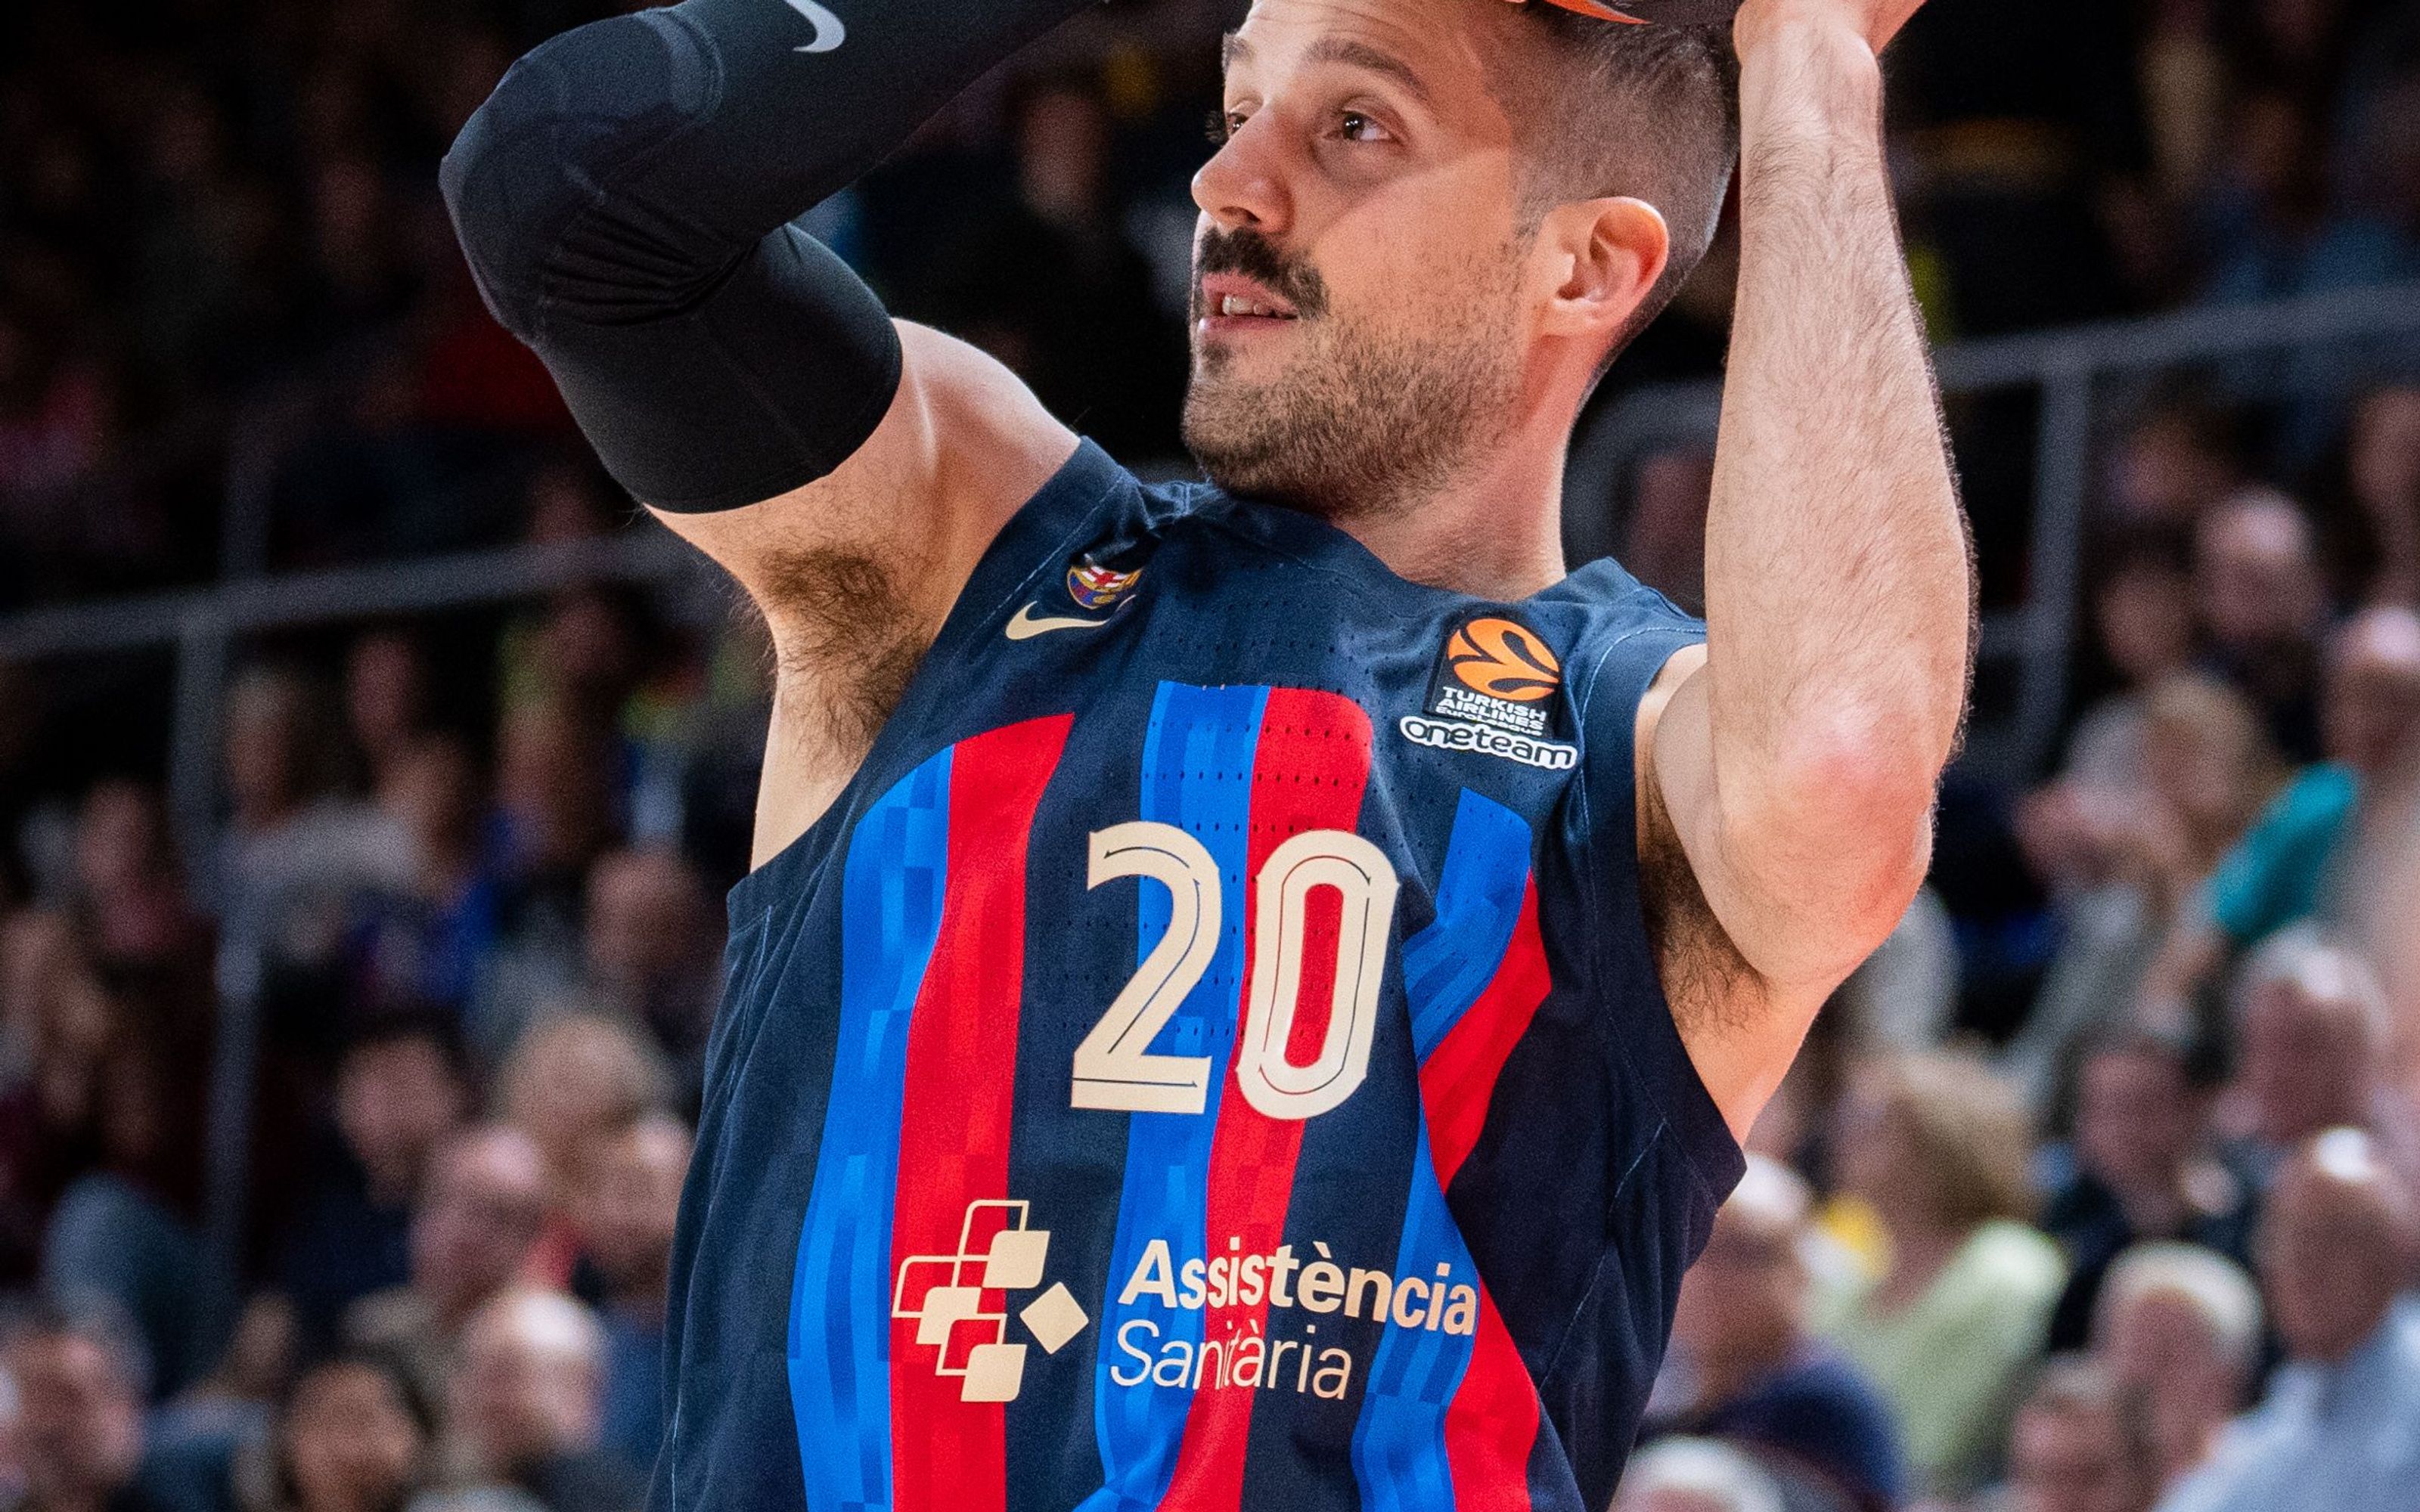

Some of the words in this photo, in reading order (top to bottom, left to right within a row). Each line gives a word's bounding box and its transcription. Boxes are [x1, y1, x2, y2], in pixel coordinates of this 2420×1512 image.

[1438, 698, 1544, 731] AIRLINES
[1443, 686, 1547, 721] TURKISH
[1404, 720, 1575, 767] oneteam
[1071, 821, 1400, 1120] 20
[1118, 1236, 1478, 1336] Assistència
[1110, 1318, 1351, 1400] Sanitària
